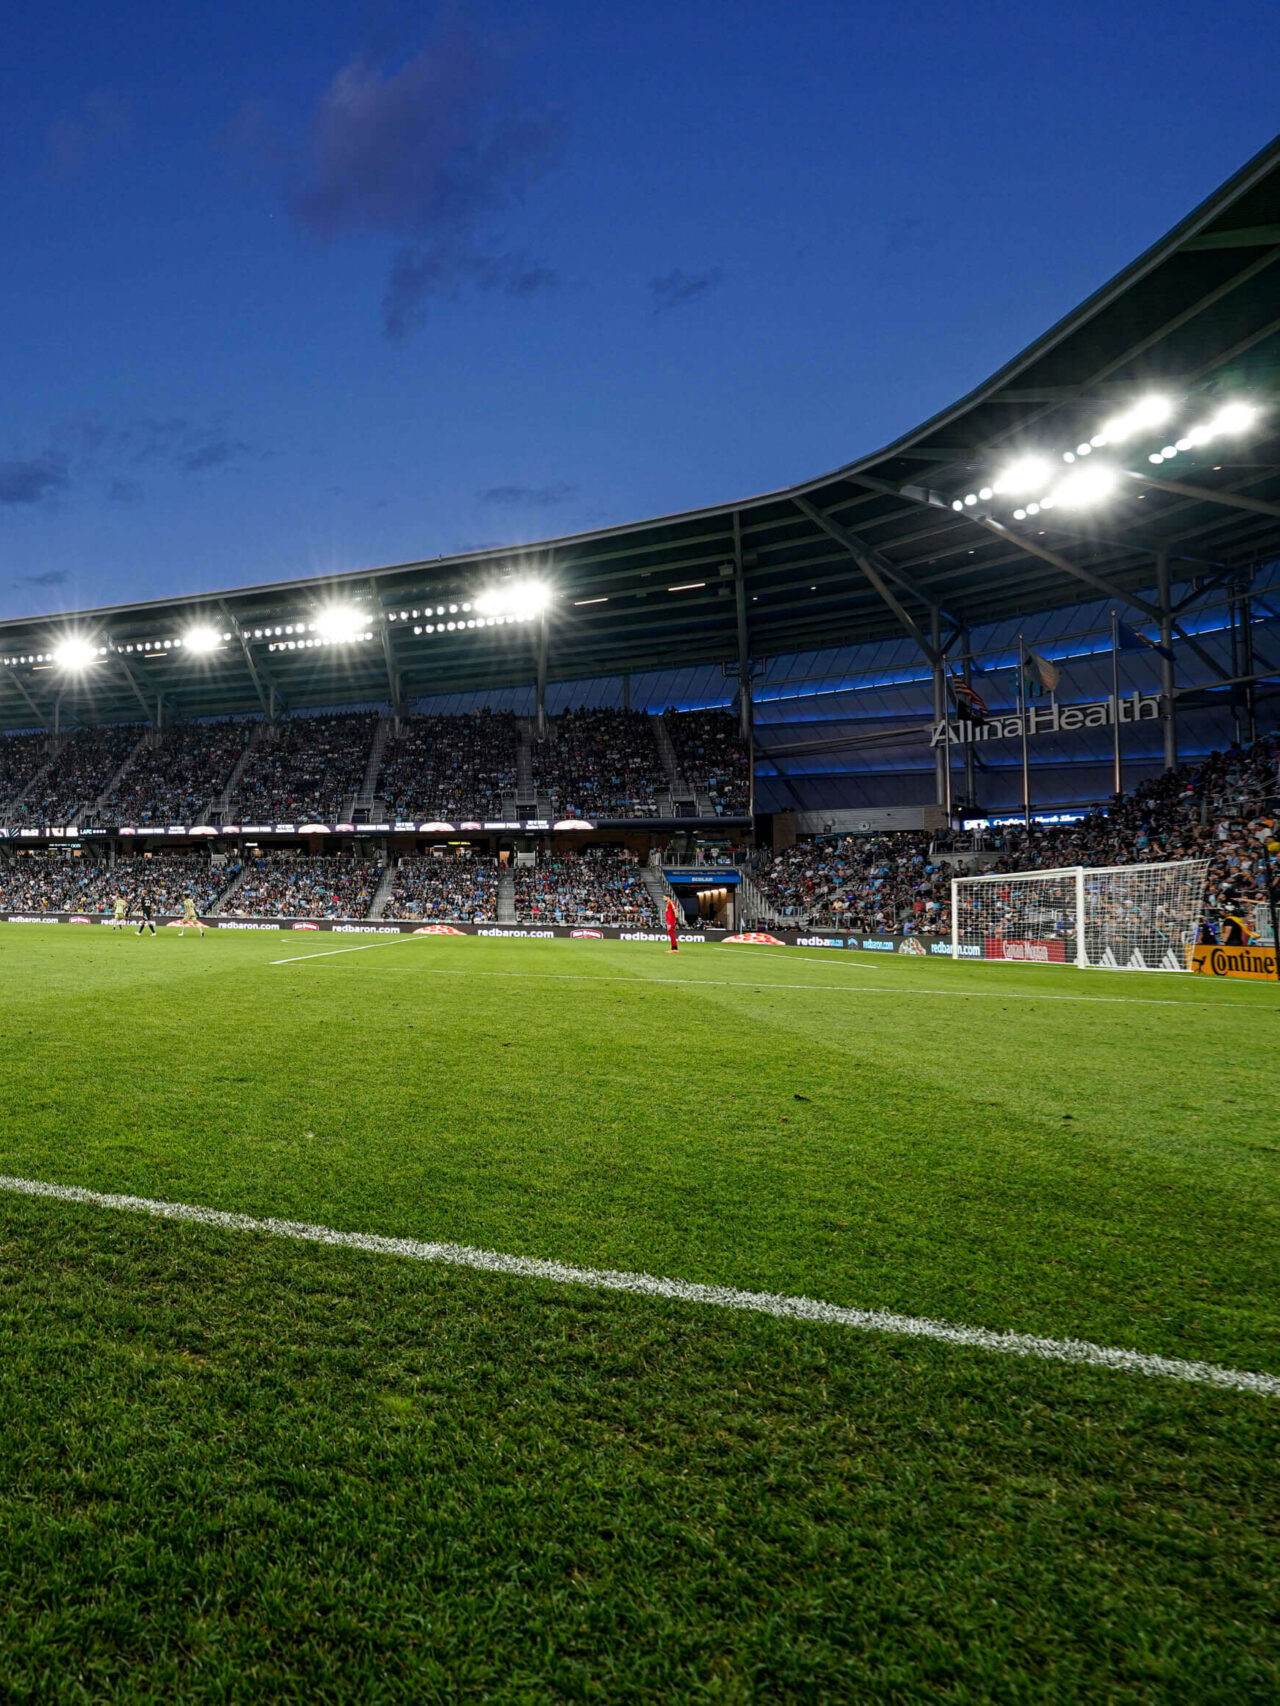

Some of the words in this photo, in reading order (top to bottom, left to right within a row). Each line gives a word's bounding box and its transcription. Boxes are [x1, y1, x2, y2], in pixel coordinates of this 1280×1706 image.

[929, 716, 1023, 747] Allina
[1028, 690, 1160, 735] Health
[218, 922, 280, 931] redbaron.com
[331, 925, 401, 934] redbaron.com
[477, 928, 555, 939] redbaron.com
